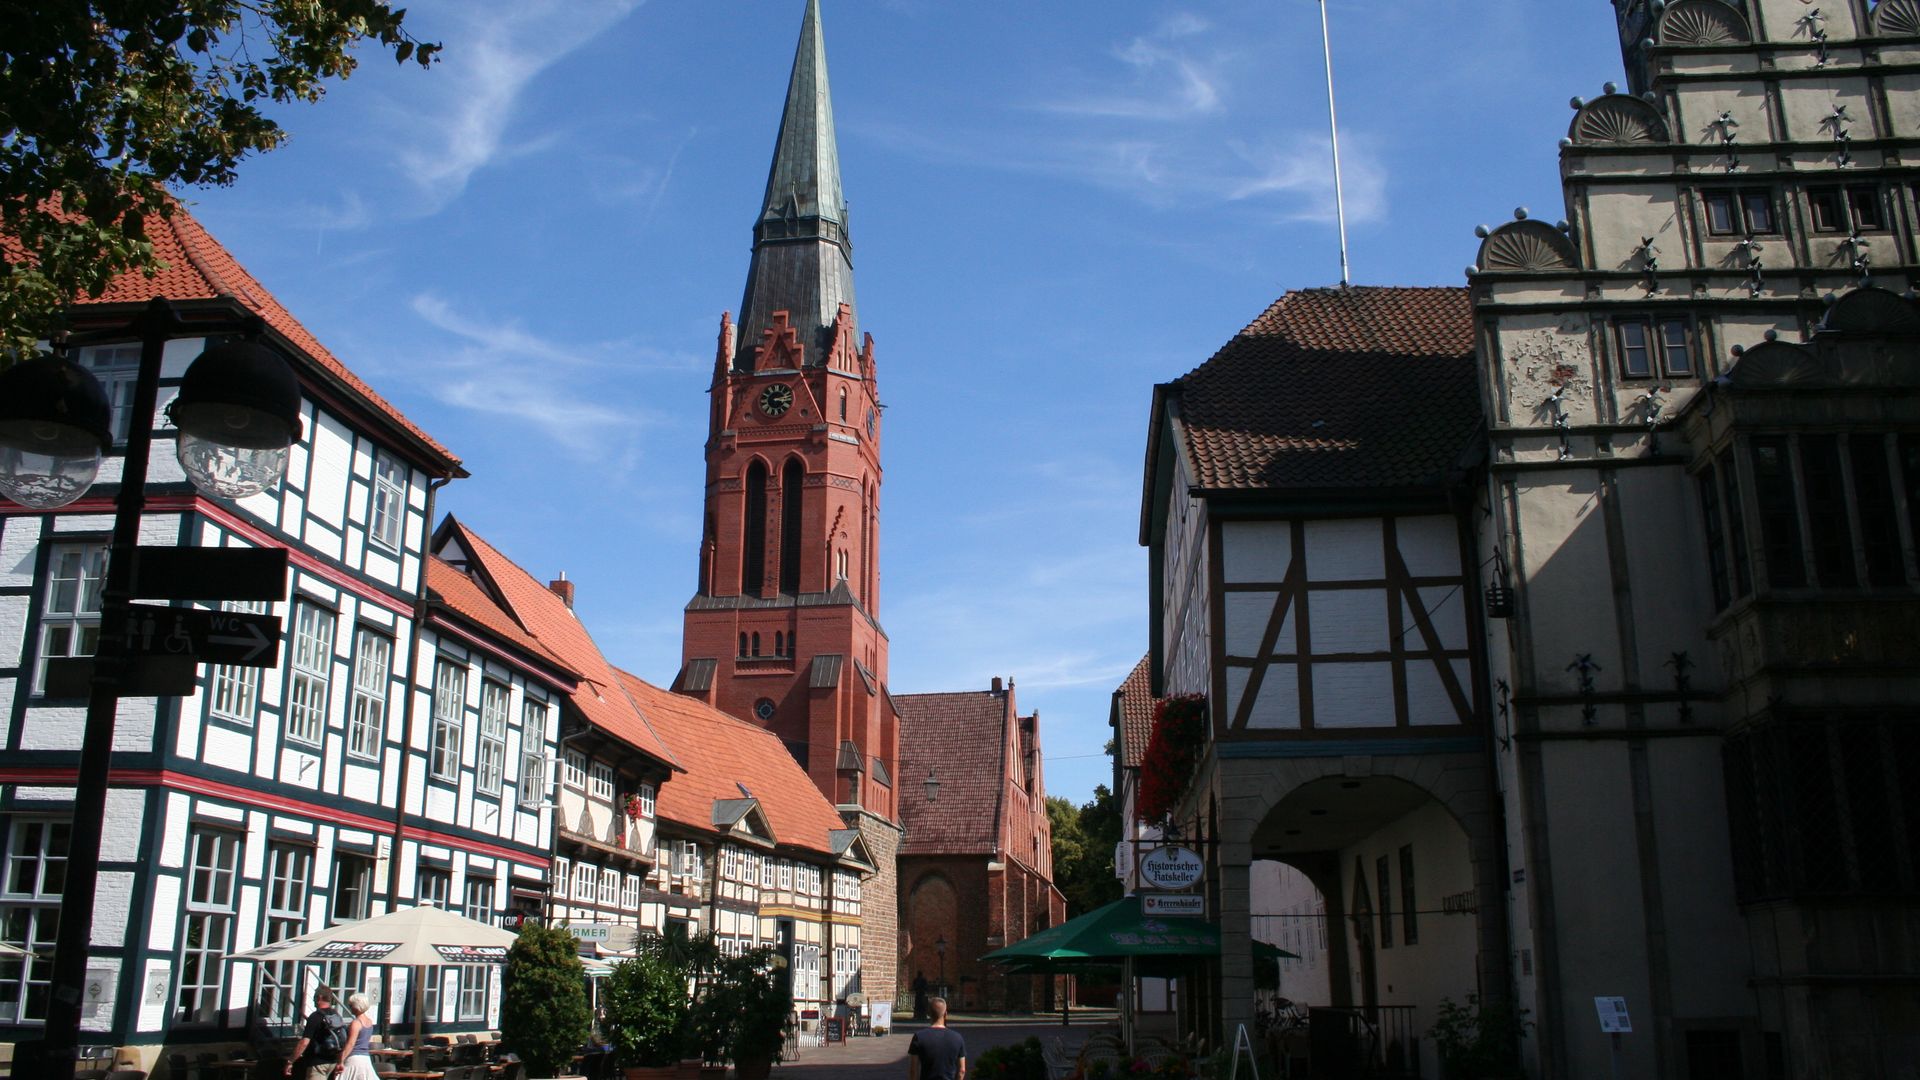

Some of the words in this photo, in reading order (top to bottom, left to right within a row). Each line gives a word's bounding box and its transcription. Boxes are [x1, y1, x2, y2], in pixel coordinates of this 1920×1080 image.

[209, 615, 241, 632] WC
[1147, 860, 1199, 872] Historischer
[1153, 870, 1195, 881] Ratskeller
[572, 927, 607, 937] RMER
[324, 942, 396, 952] CUP&CINO
[437, 946, 507, 956] CUP&CINO
